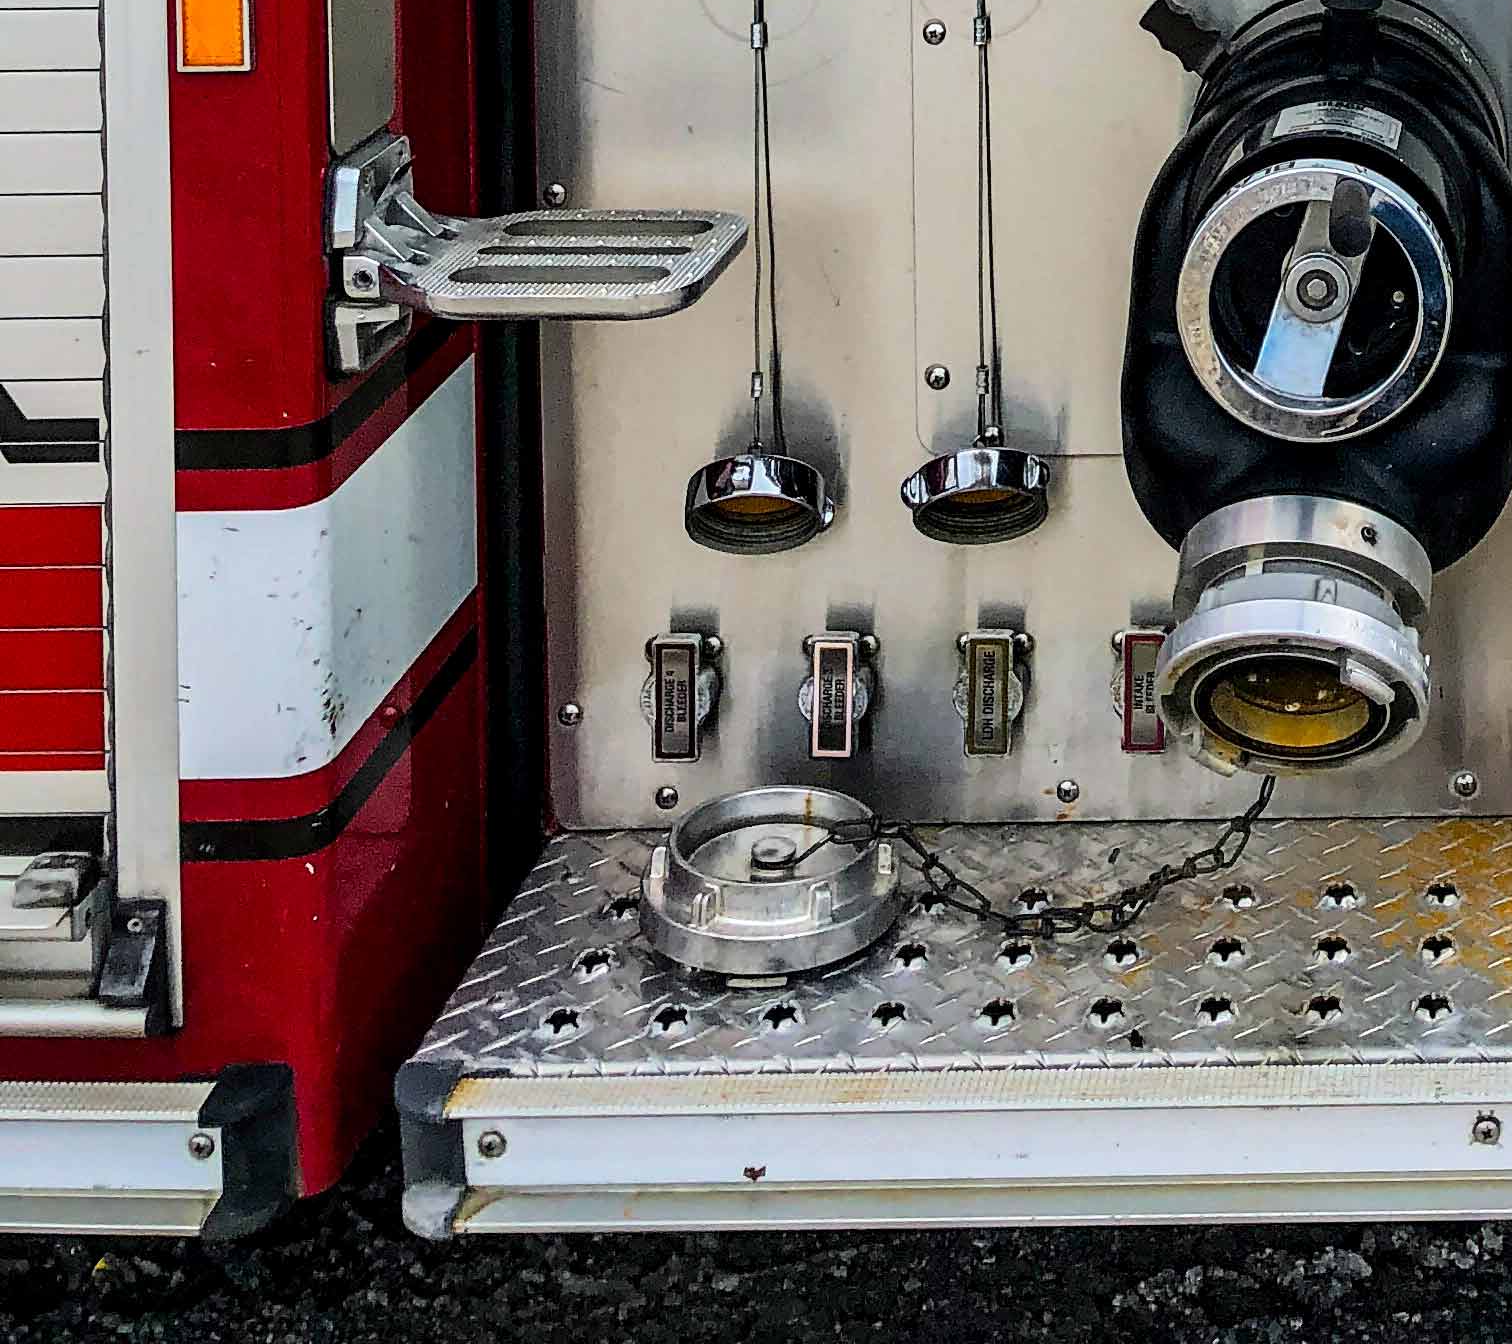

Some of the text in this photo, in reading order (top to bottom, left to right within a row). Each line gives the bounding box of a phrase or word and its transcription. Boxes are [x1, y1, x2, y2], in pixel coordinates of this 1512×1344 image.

[664, 678, 675, 733] DISCHARGE
[676, 679, 688, 723] BLEEDER
[833, 678, 845, 721] BLEEDER
[982, 651, 996, 741] LDH DISCHARGE
[1133, 673, 1145, 710] INTAKE
